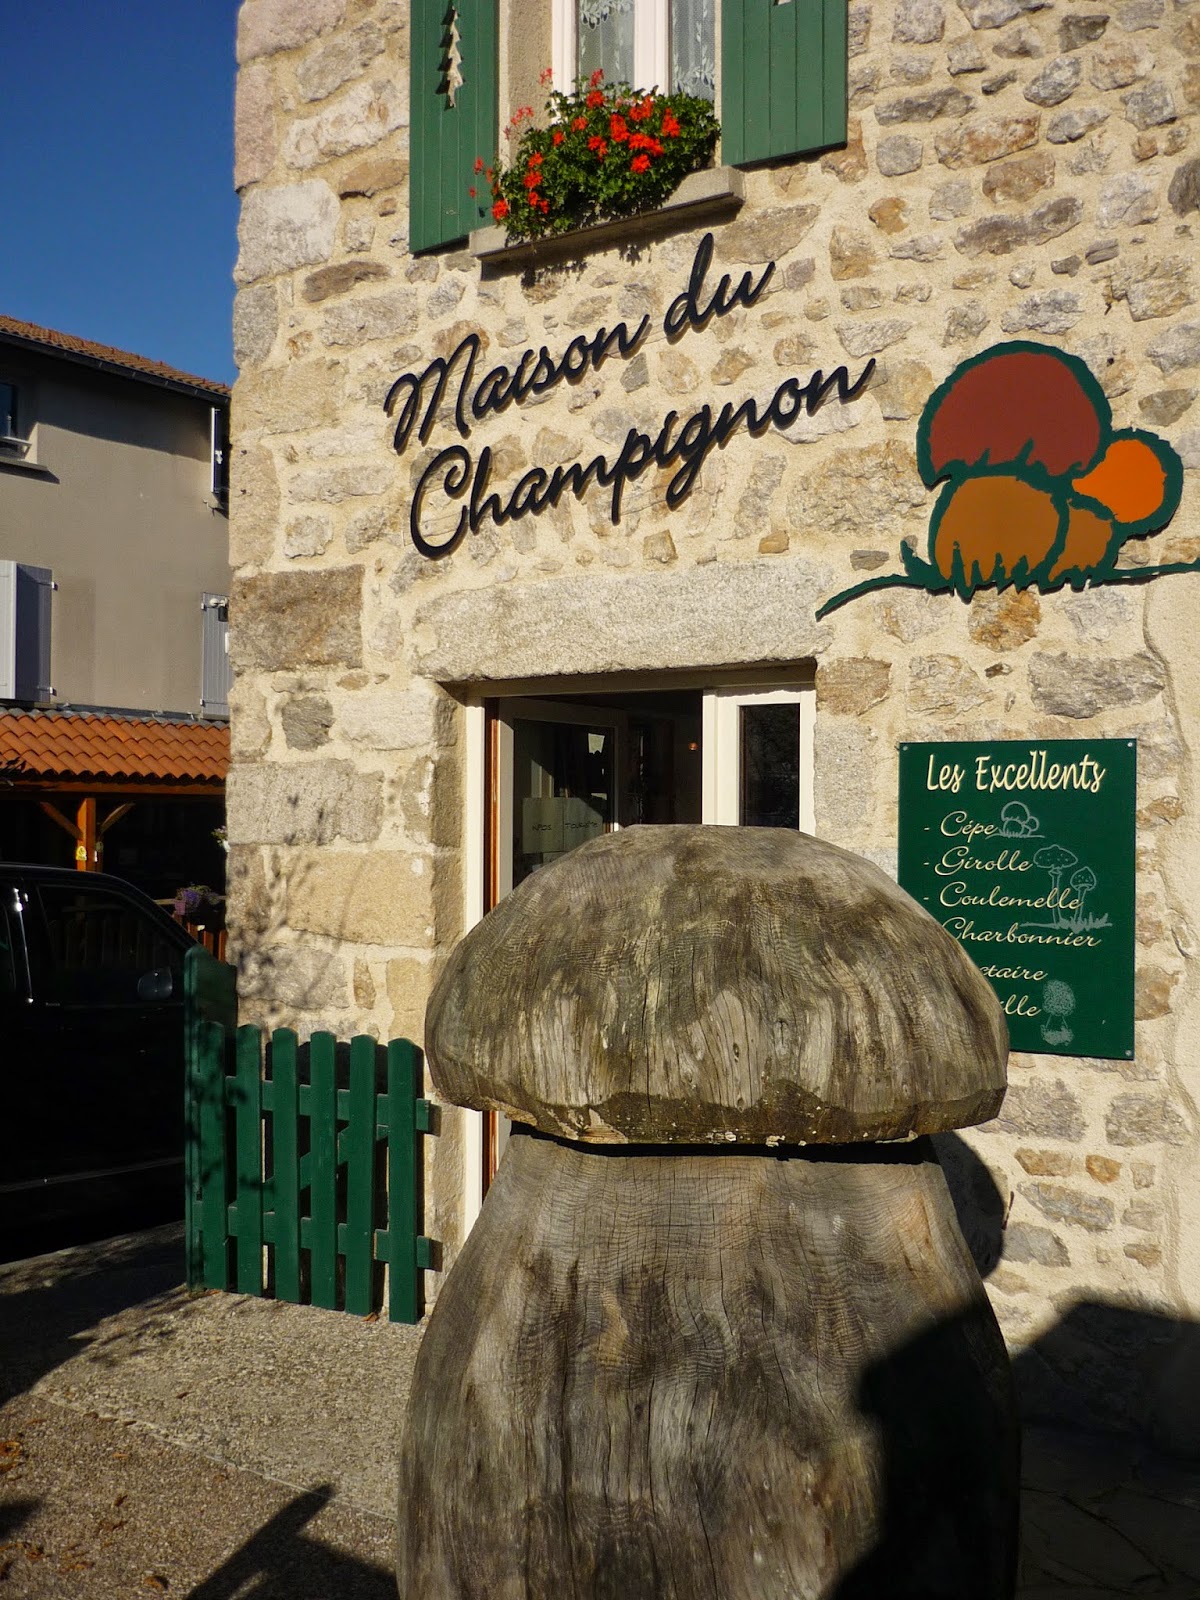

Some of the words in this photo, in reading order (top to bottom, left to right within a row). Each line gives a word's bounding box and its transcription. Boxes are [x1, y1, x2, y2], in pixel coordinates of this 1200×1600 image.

[383, 313, 651, 456] Maison
[663, 232, 777, 340] du
[410, 357, 877, 561] Champignon
[926, 753, 966, 793] Les
[974, 749, 1106, 794] Excellents
[934, 845, 1033, 876] Girolle
[939, 881, 1084, 910] Coulemelle
[942, 916, 1102, 948] Charbonnier
[979, 964, 1048, 981] ctaire
